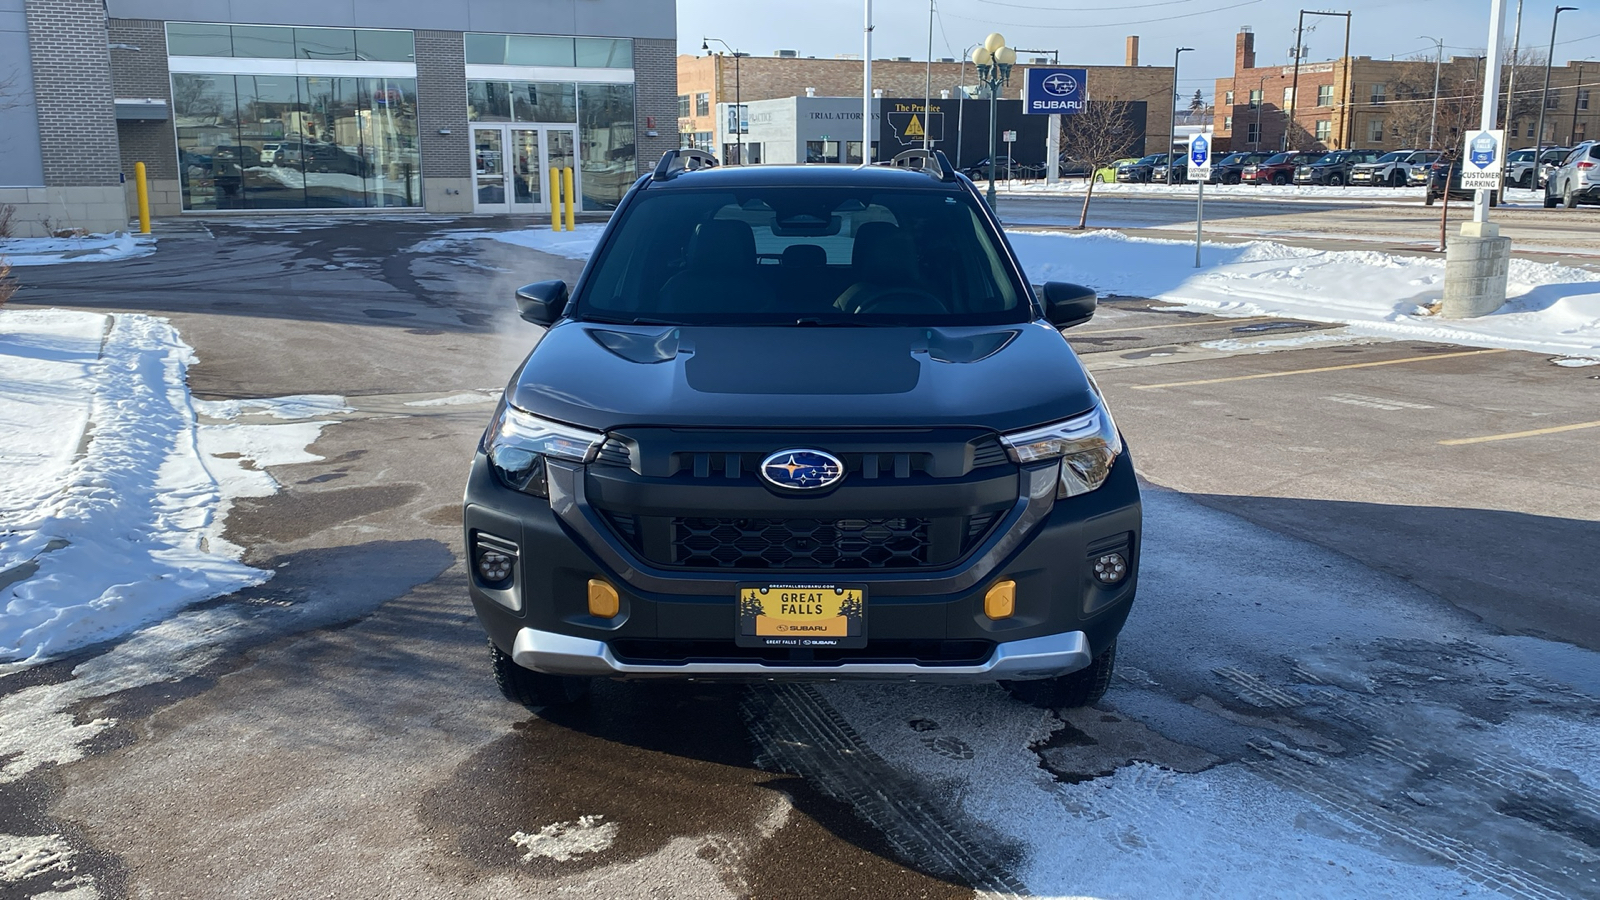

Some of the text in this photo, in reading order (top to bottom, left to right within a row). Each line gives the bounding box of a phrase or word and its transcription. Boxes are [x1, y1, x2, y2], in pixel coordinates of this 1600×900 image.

[895, 104, 940, 112] The Praice
[1033, 101, 1082, 109] SUBARU
[781, 593, 823, 602] GREAT
[782, 604, 823, 614] FALLS
